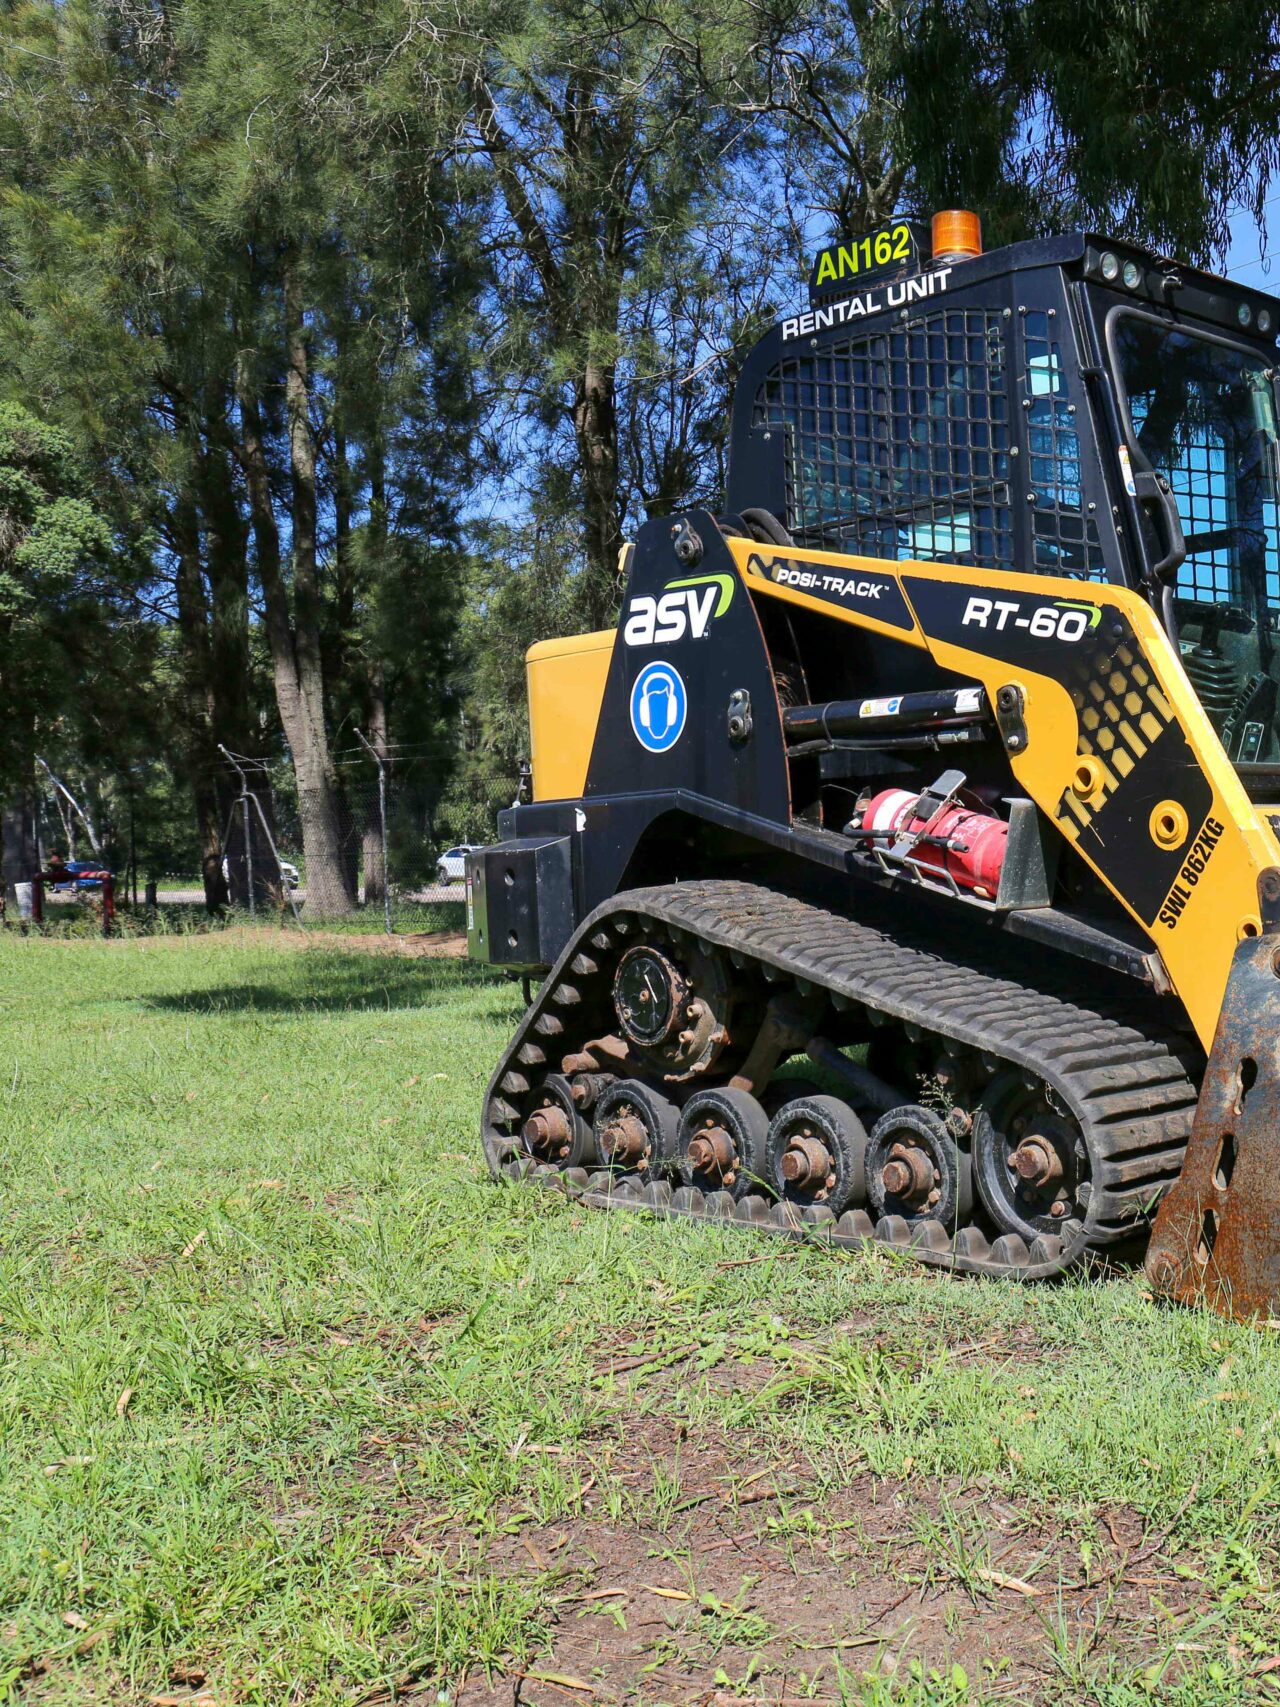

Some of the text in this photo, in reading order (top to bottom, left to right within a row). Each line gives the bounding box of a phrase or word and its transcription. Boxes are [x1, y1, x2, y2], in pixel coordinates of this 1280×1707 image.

[816, 225, 910, 286] AN162
[782, 267, 952, 341] RENTAL UNIT
[961, 597, 1088, 642] RT-60
[1158, 817, 1225, 930] SWL 862KG
